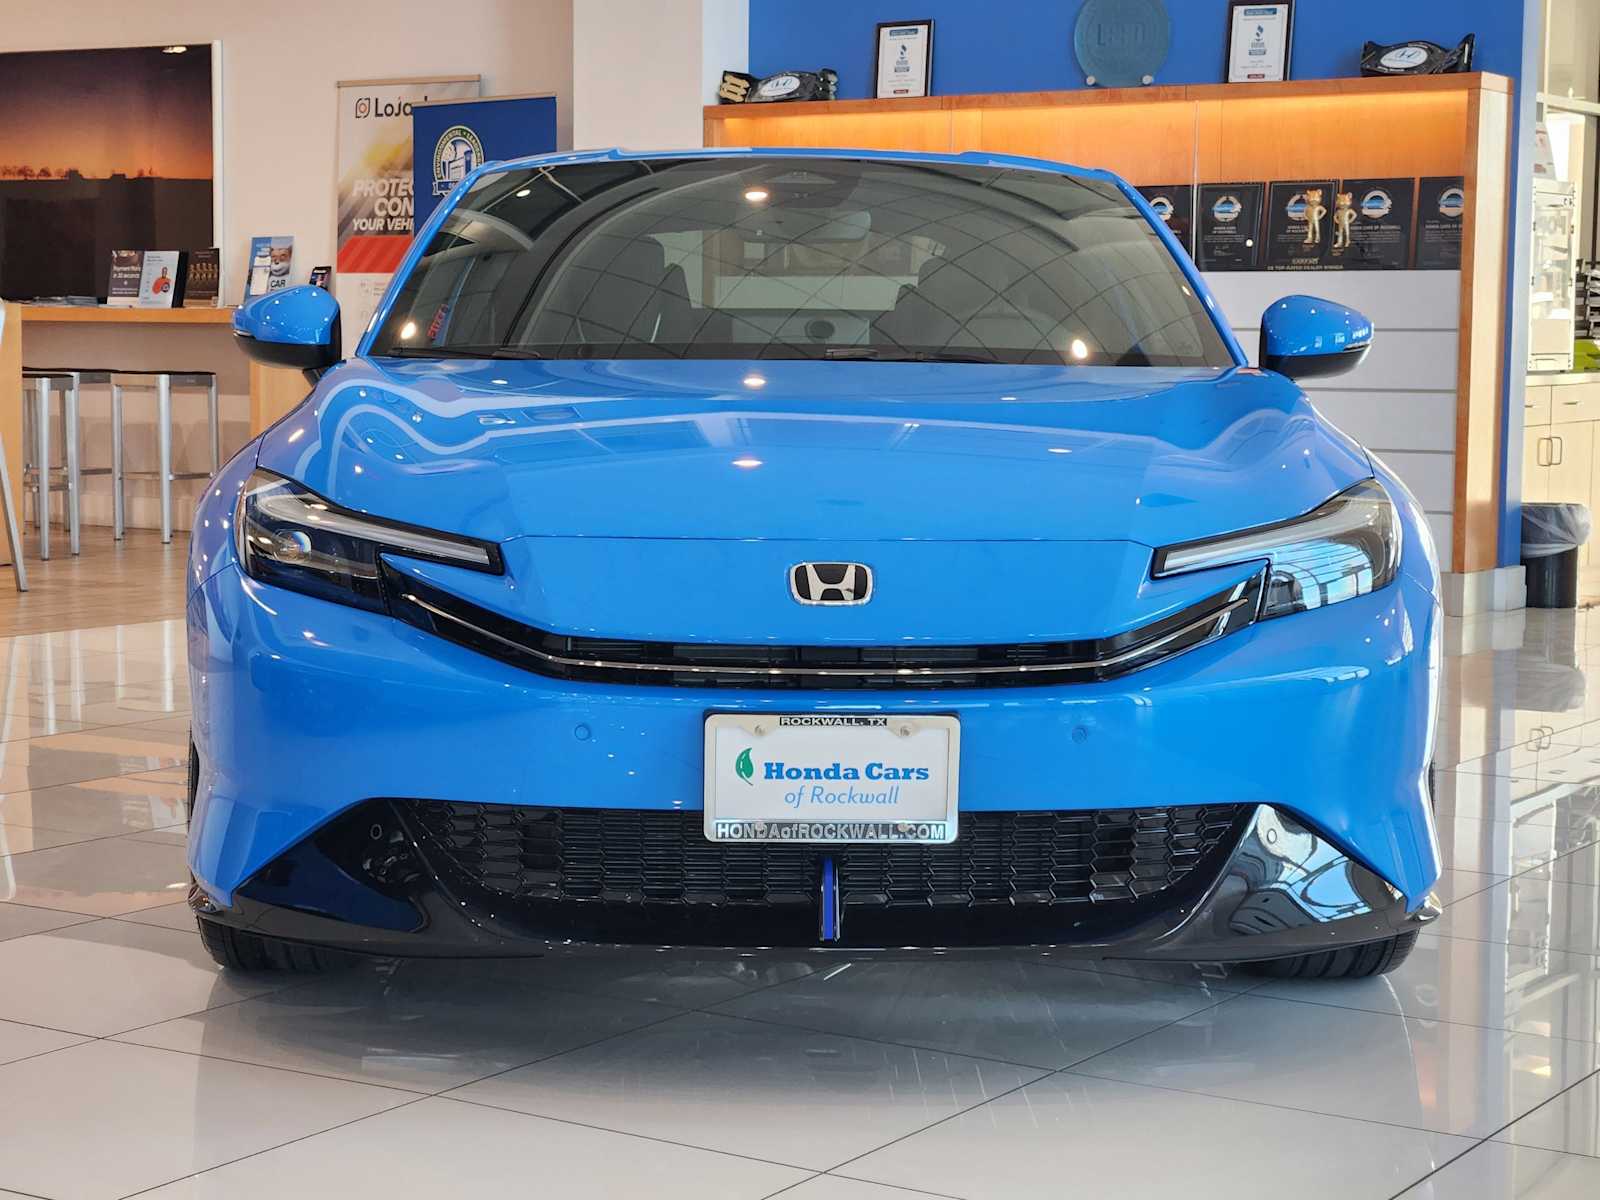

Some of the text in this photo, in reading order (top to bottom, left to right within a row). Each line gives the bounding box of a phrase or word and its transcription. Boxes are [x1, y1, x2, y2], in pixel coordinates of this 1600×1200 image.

[352, 218, 385, 231] YOUR
[270, 279, 286, 288] CAR
[868, 718, 885, 727] TX
[763, 762, 930, 781] Honda Cars
[784, 784, 900, 808] of Rockwall
